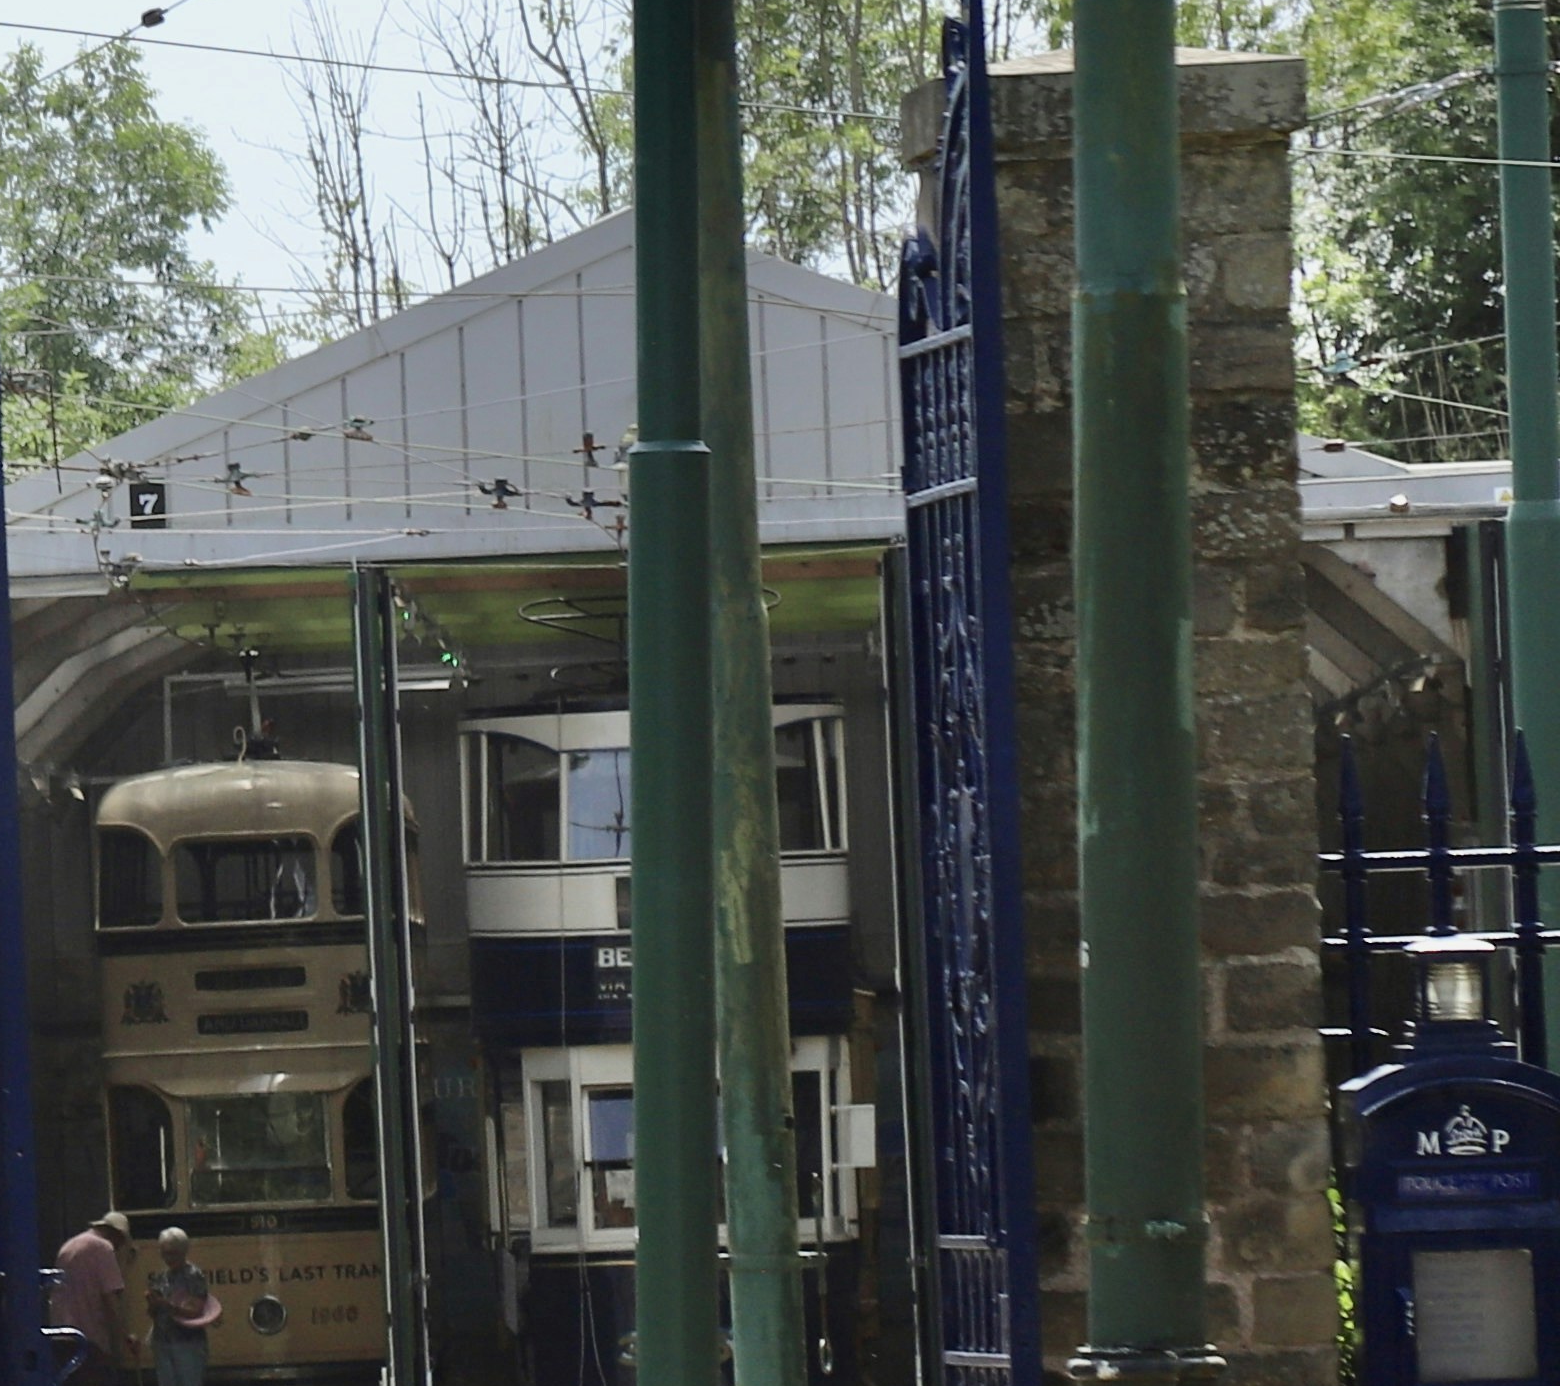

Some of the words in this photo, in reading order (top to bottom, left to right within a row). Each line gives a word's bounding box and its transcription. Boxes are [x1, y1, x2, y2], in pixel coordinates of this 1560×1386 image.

[138, 493, 159, 515] 7
[1416, 1131, 1441, 1156] M
[1491, 1128, 1511, 1154] P
[279, 1264, 326, 1283] LAST
